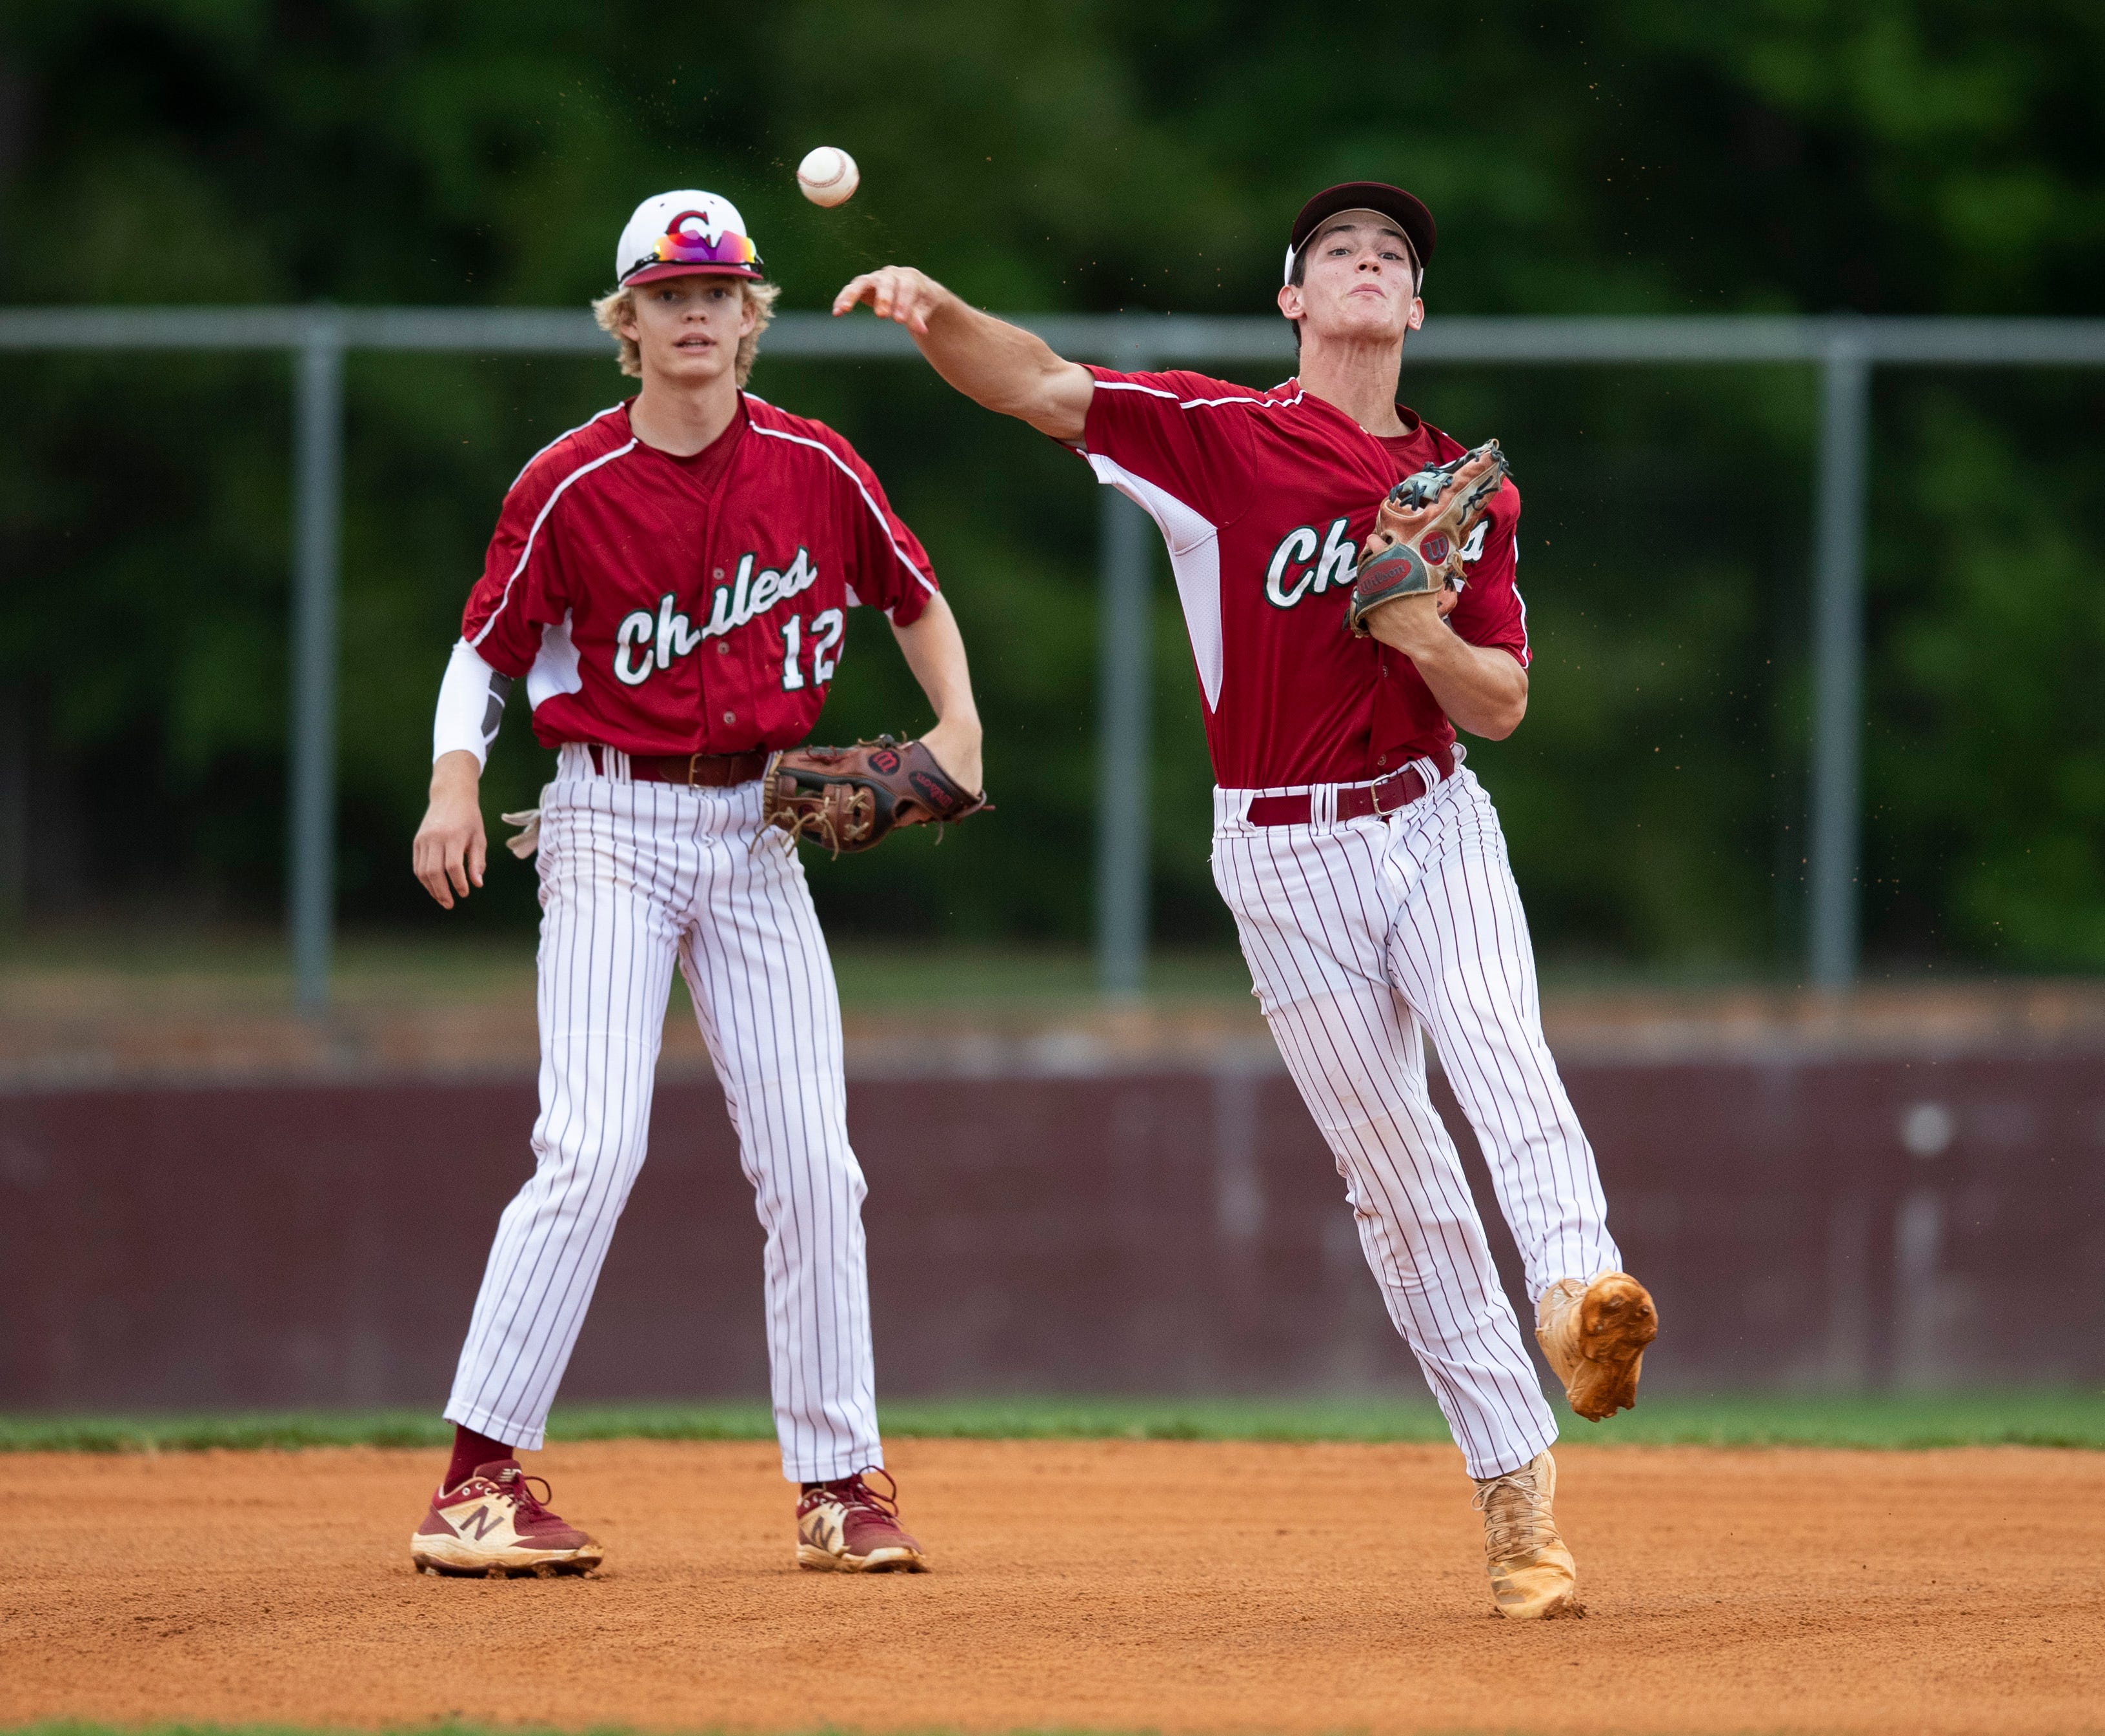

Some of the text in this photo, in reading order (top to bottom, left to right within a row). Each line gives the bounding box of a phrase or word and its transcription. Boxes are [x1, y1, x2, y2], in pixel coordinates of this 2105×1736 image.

[1264, 516, 1490, 609] Chs
[1360, 564, 1405, 592] Wilson
[613, 545, 818, 686] Chiles
[781, 607, 843, 691] 12
[459, 1505, 505, 1541] N
[811, 1515, 836, 1551] N
